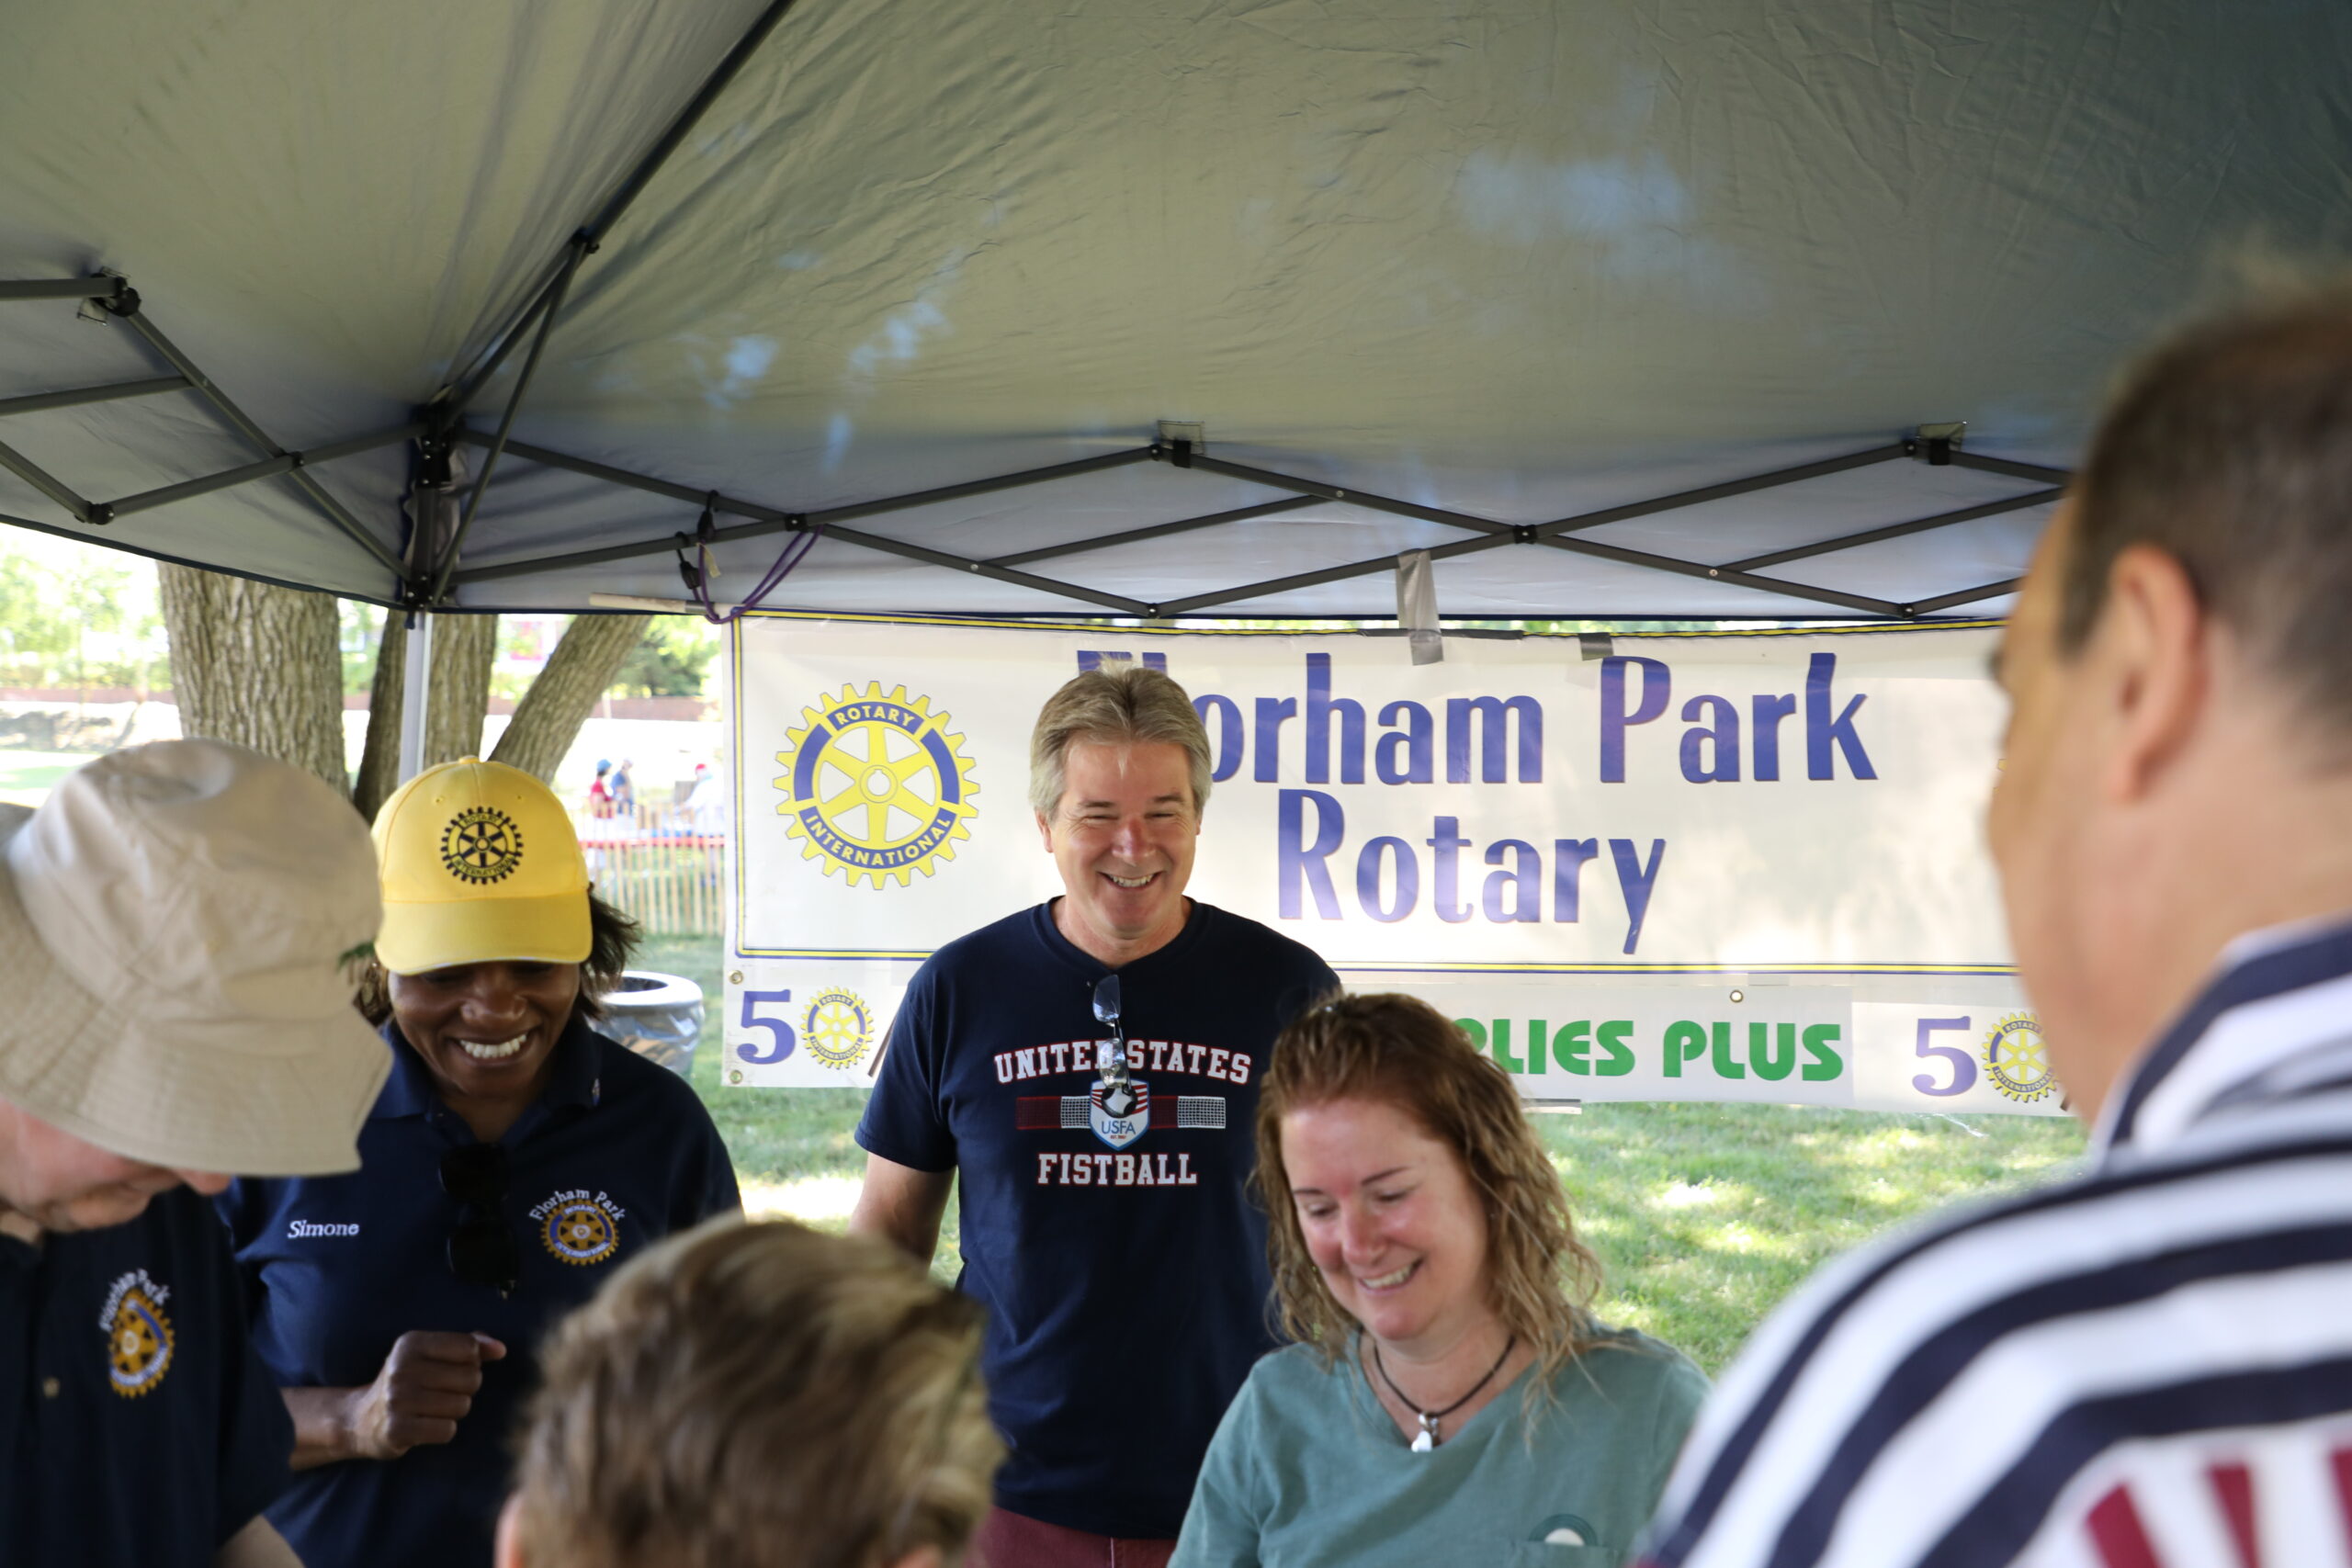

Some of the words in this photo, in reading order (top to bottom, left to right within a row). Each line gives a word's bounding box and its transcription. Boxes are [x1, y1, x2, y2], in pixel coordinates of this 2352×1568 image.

[834, 705, 915, 727] ROTARY
[1077, 650, 1544, 784] orham
[1600, 652, 1880, 784] Park
[805, 814, 952, 866] INTERNATIONAL
[1278, 788, 1668, 955] Rotary
[821, 995, 852, 1004] ROTARY
[1125, 1039, 1251, 1085] STATES
[1663, 1019, 1844, 1082] PLUS
[1101, 1121, 1136, 1135] USFA
[1037, 1153, 1198, 1185] FISTBALL
[528, 1189, 591, 1221] Florham
[594, 1190, 626, 1221] Park
[287, 1219, 360, 1239] Simone
